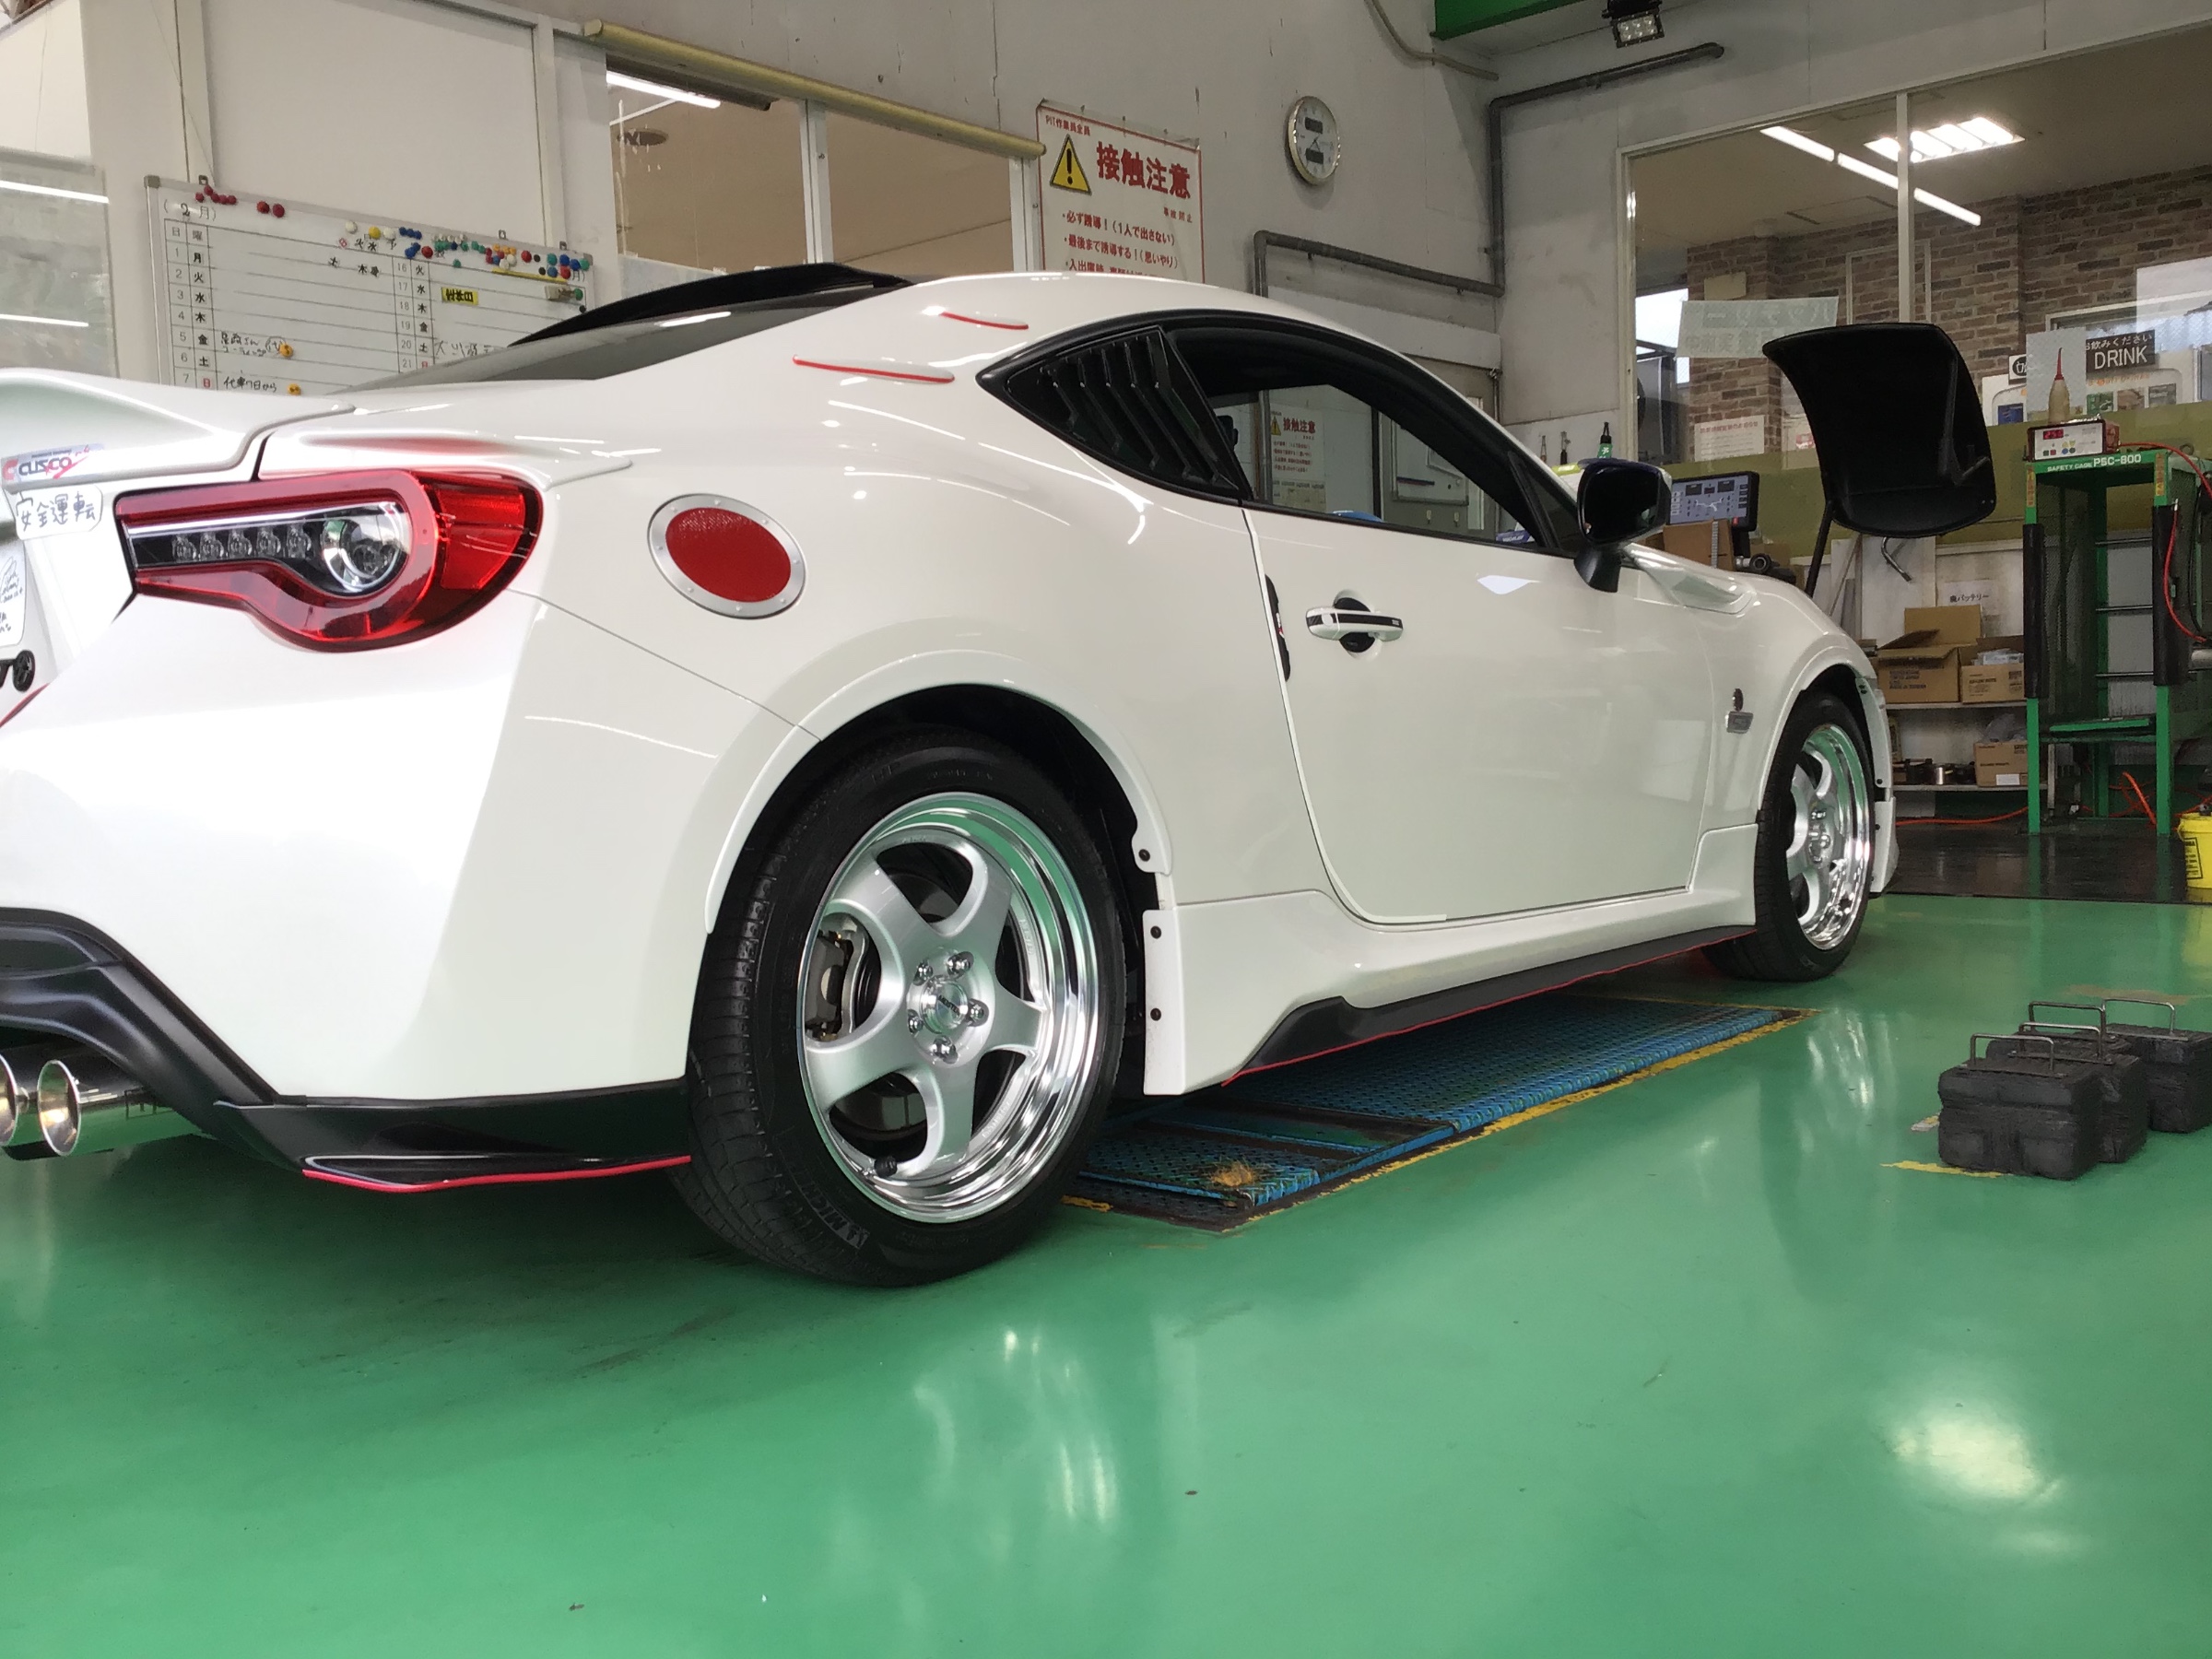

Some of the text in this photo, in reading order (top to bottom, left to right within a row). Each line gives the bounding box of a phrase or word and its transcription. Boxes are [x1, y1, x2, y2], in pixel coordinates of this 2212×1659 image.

[1096, 140, 1191, 199] 接触注意
[193, 252, 203, 264] 月
[175, 268, 205, 284] 2 火
[398, 280, 408, 291] 17
[417, 284, 426, 295] 水
[177, 289, 206, 303] 3 水
[178, 311, 206, 324] 4 木
[179, 331, 187, 342] 5
[197, 333, 208, 346] 金
[401, 339, 412, 350] 20
[418, 342, 428, 354] 土
[181, 352, 210, 368] 6 土
[2094, 345, 2147, 371] DRINK
[203, 377, 211, 388] 日
[18, 456, 73, 476] CUSCO
[2093, 453, 2142, 467] PSC-800
[16, 490, 96, 533] 安全運転
